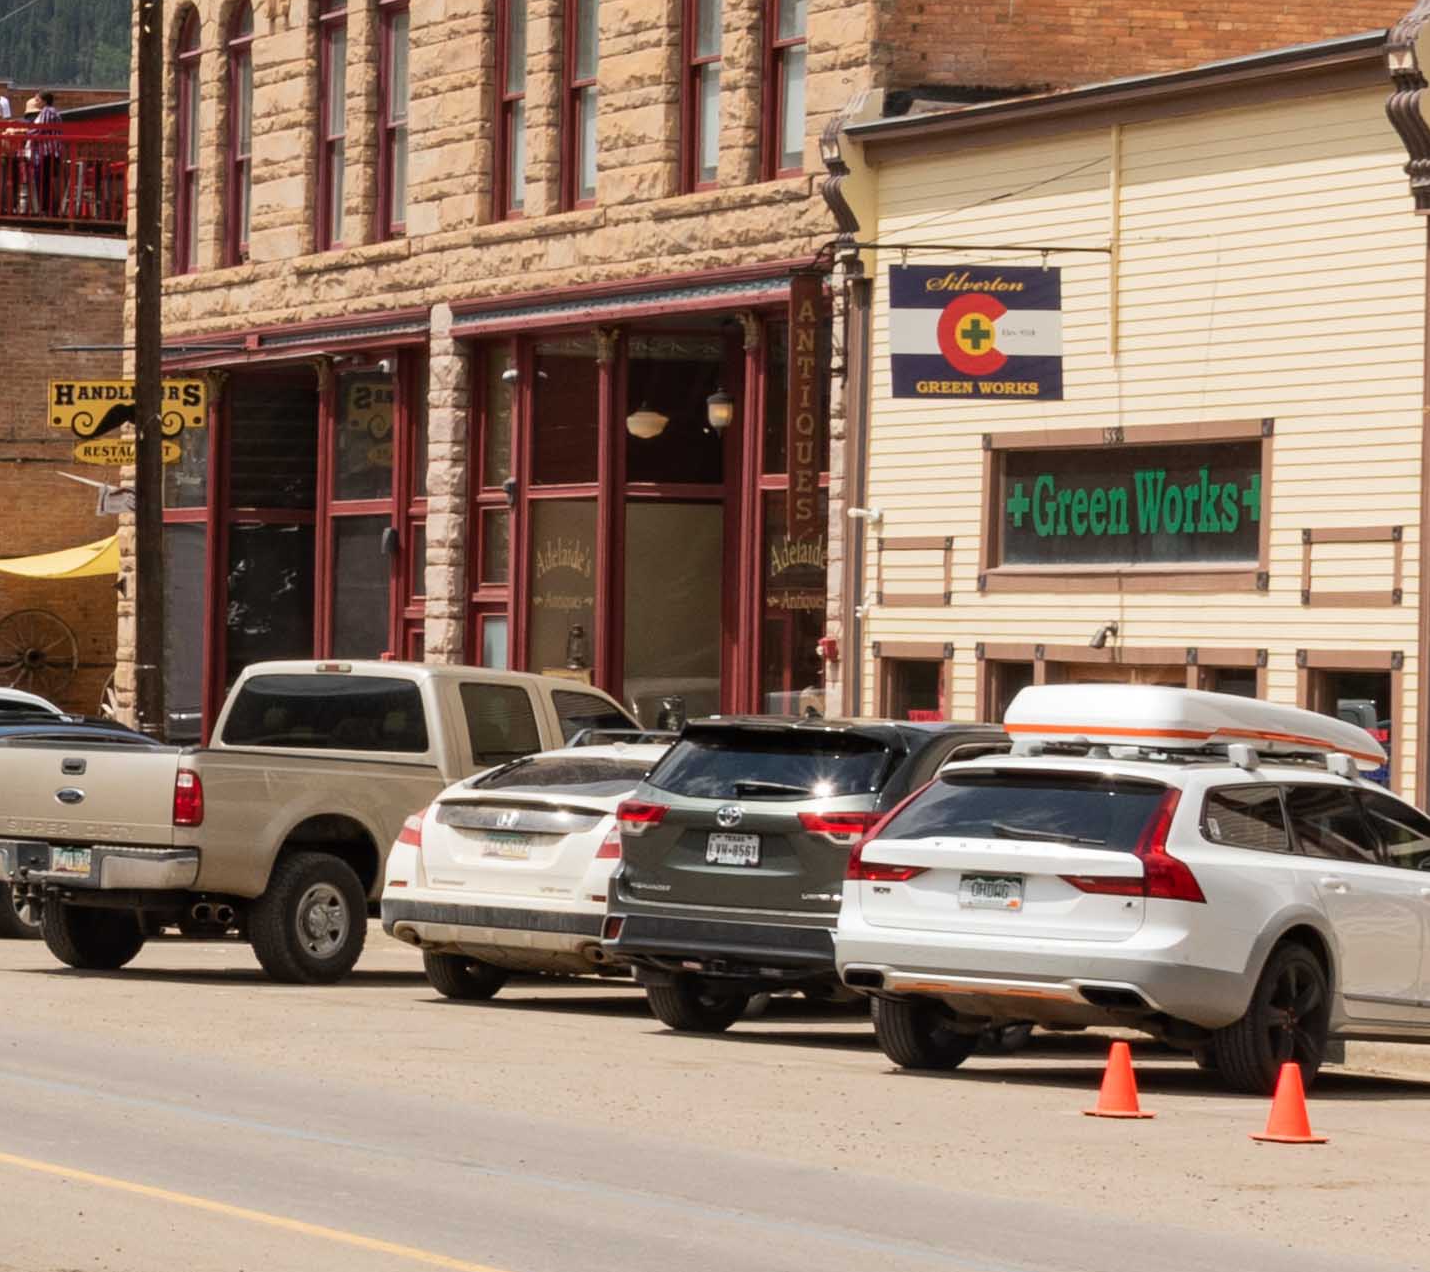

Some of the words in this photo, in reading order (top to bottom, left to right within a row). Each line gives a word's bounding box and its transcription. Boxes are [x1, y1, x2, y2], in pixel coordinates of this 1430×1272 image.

[925, 272, 1024, 292] Silverton
[54, 384, 201, 407] HANDLRS
[916, 381, 973, 394] GREEN
[978, 382, 1039, 395] WORKS
[796, 300, 817, 520] ANTIQUES
[1032, 473, 1130, 536] Green
[1134, 465, 1240, 535] Works
[781, 590, 825, 615] Antique
[8, 820, 72, 836] SUPER
[85, 825, 137, 839] DUTY
